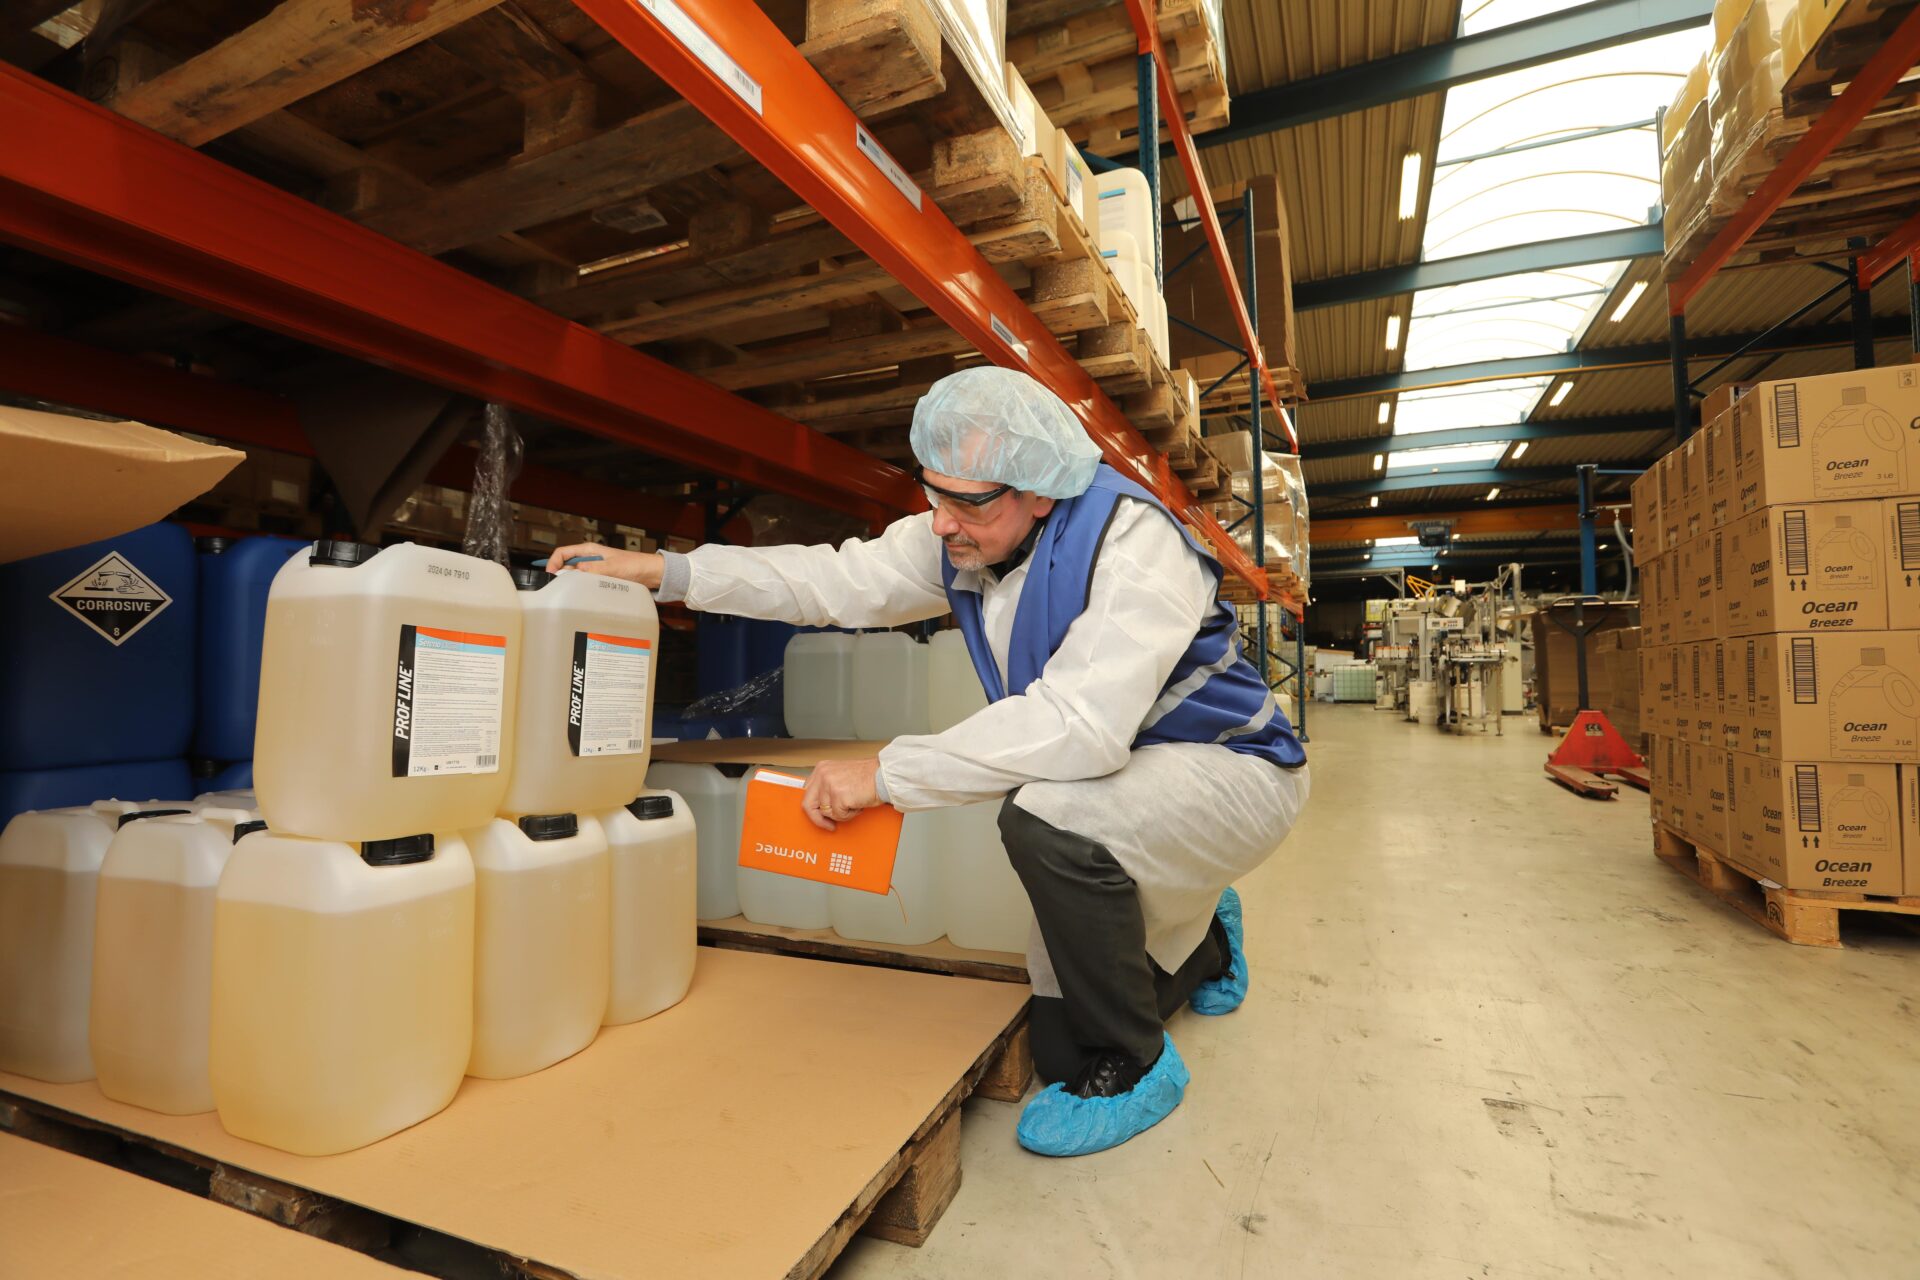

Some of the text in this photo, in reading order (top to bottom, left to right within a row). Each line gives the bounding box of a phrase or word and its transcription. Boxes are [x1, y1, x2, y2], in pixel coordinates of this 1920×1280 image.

[1826, 458, 1869, 471] Ocean
[1834, 471, 1864, 480] Breeze
[1740, 482, 1758, 500] Ocean
[428, 564, 470, 580] 2024 04 7910
[1750, 560, 1770, 575] Ocean
[1824, 564, 1853, 572] Ocean
[1698, 574, 1712, 588] Ocean
[1754, 576, 1769, 588] Breeze
[76, 599, 152, 612] CORROSIVE
[1802, 600, 1858, 614] Ocean
[1810, 618, 1854, 628] Breeze
[113, 627, 120, 637] 8
[570, 692, 582, 726] PROF
[396, 699, 410, 740] PROF
[1844, 722, 1888, 732] Ocean
[1753, 728, 1772, 740] Ocean
[1851, 734, 1882, 742] Breeze
[1710, 788, 1724, 801] Ocean
[1763, 806, 1782, 820] Ocean
[755, 842, 817, 864] Normec
[1814, 860, 1872, 872] Ocean
[1822, 877, 1868, 887] Breeze
